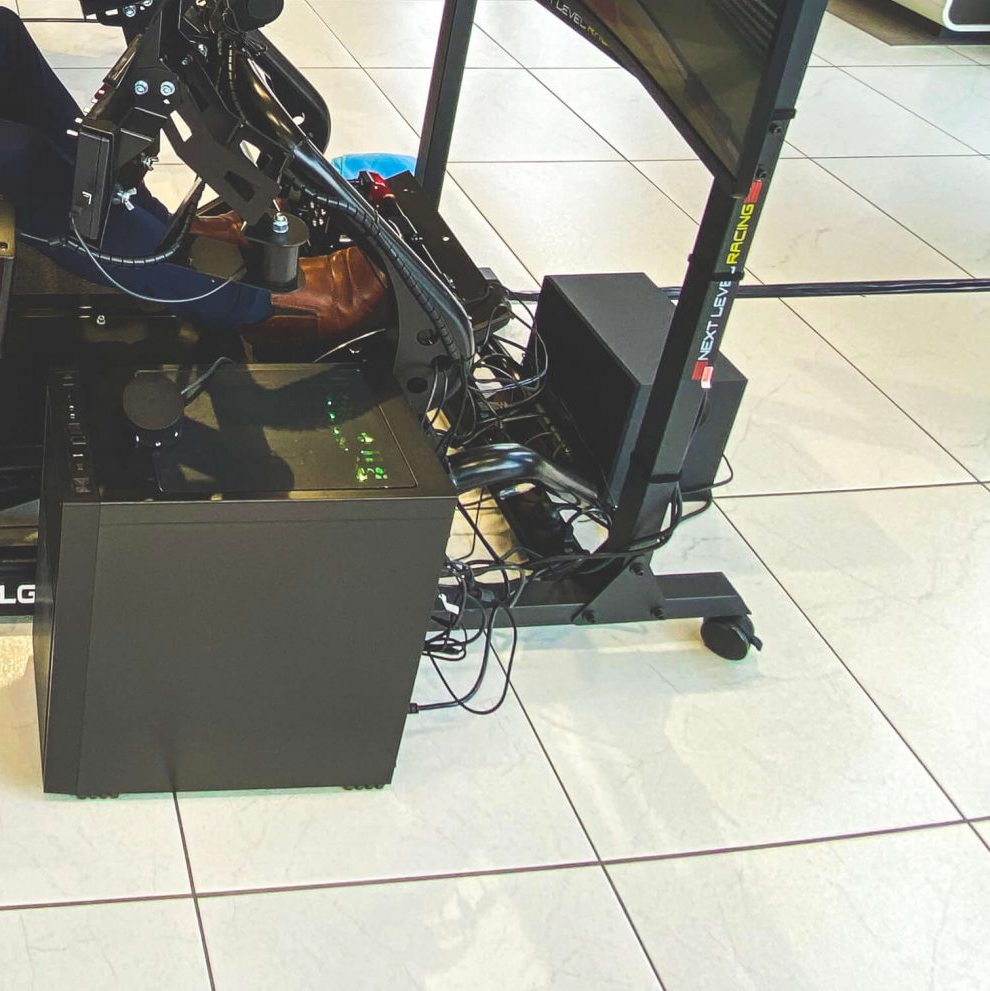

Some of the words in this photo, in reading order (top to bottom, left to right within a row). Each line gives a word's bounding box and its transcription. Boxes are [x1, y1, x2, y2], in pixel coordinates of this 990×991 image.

[555, 0, 587, 30] LEVEL
[697, 320, 719, 362] NEXT
[726, 203, 755, 265] RACING
